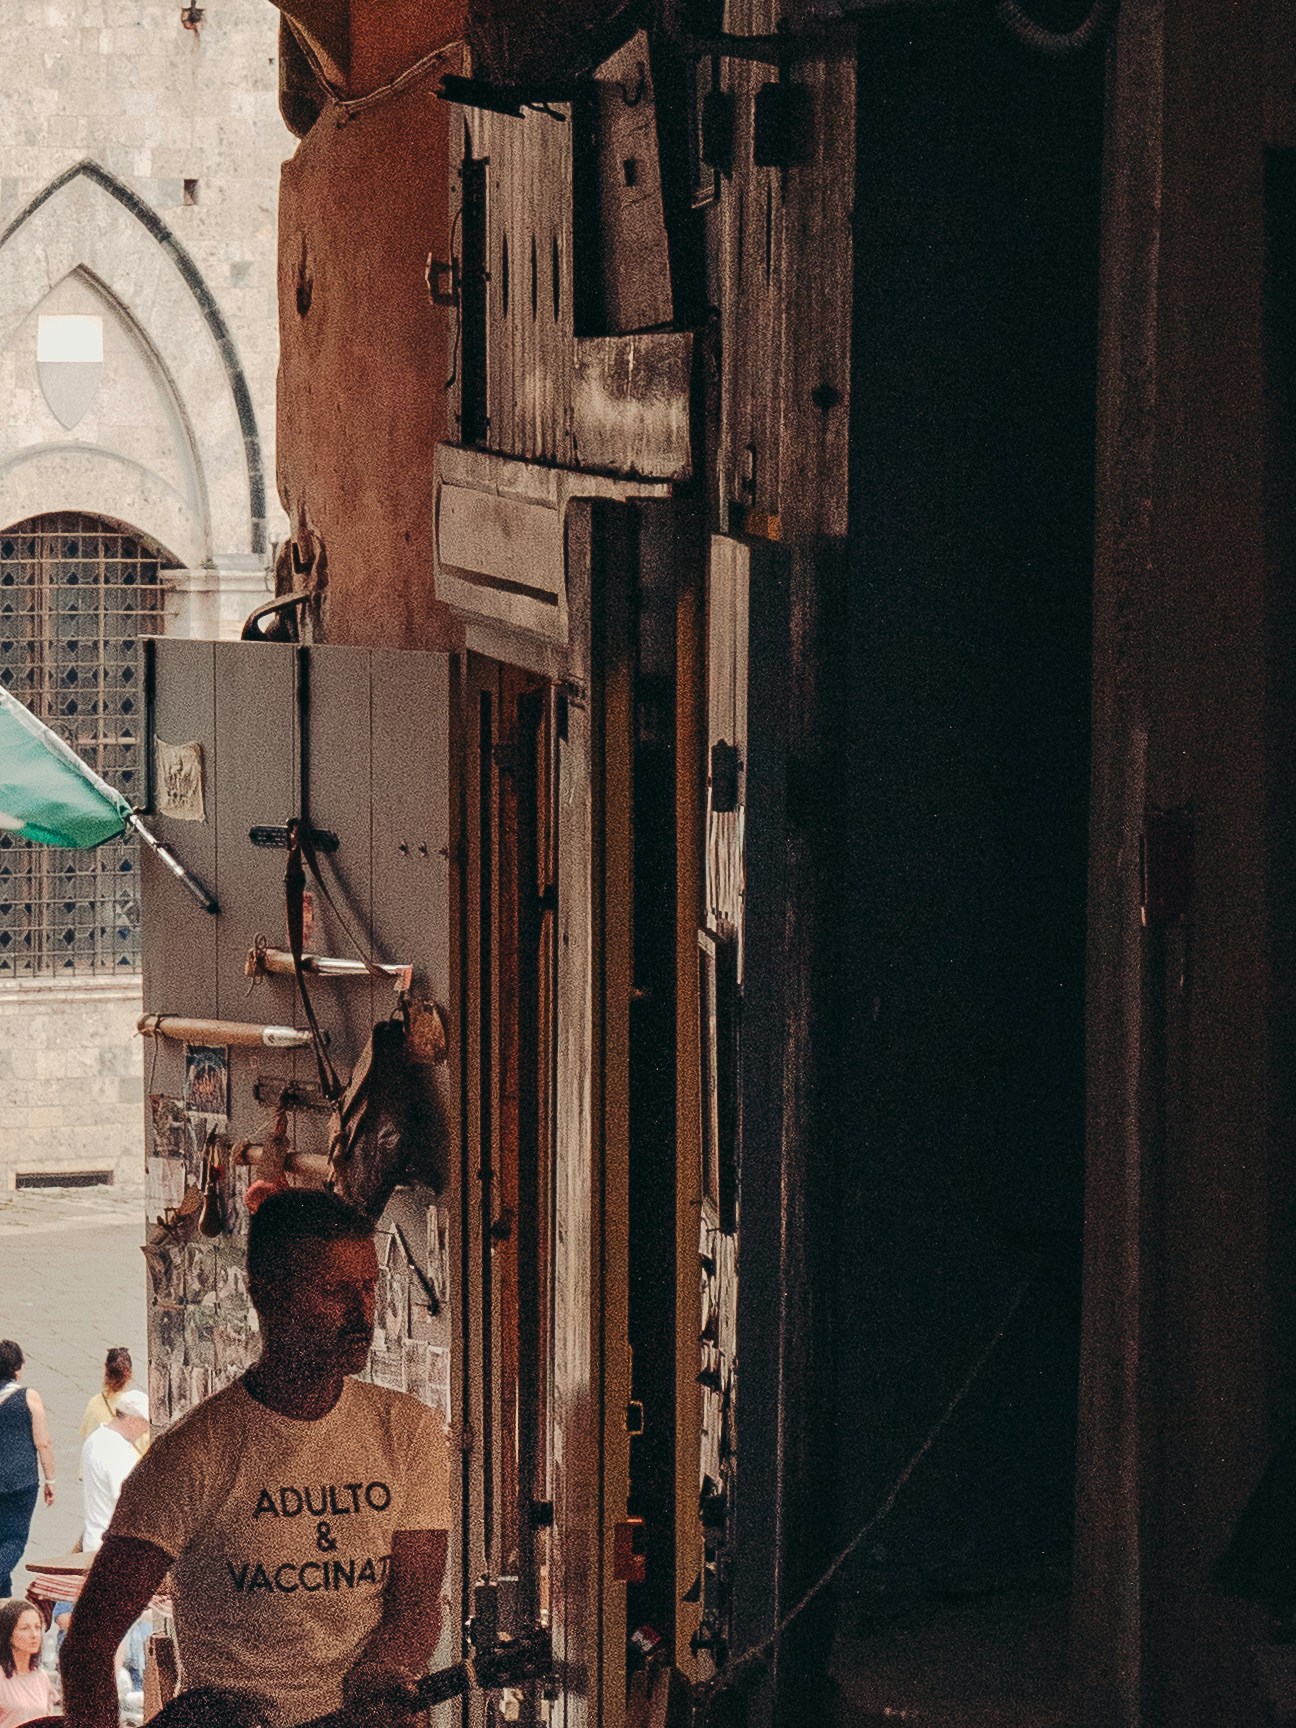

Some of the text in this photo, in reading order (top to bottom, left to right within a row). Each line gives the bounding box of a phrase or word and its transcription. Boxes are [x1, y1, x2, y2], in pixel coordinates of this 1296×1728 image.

[252, 1480, 392, 1520] ADULTO
[316, 1520, 338, 1553] &
[226, 1554, 393, 1594] VACCINAT
